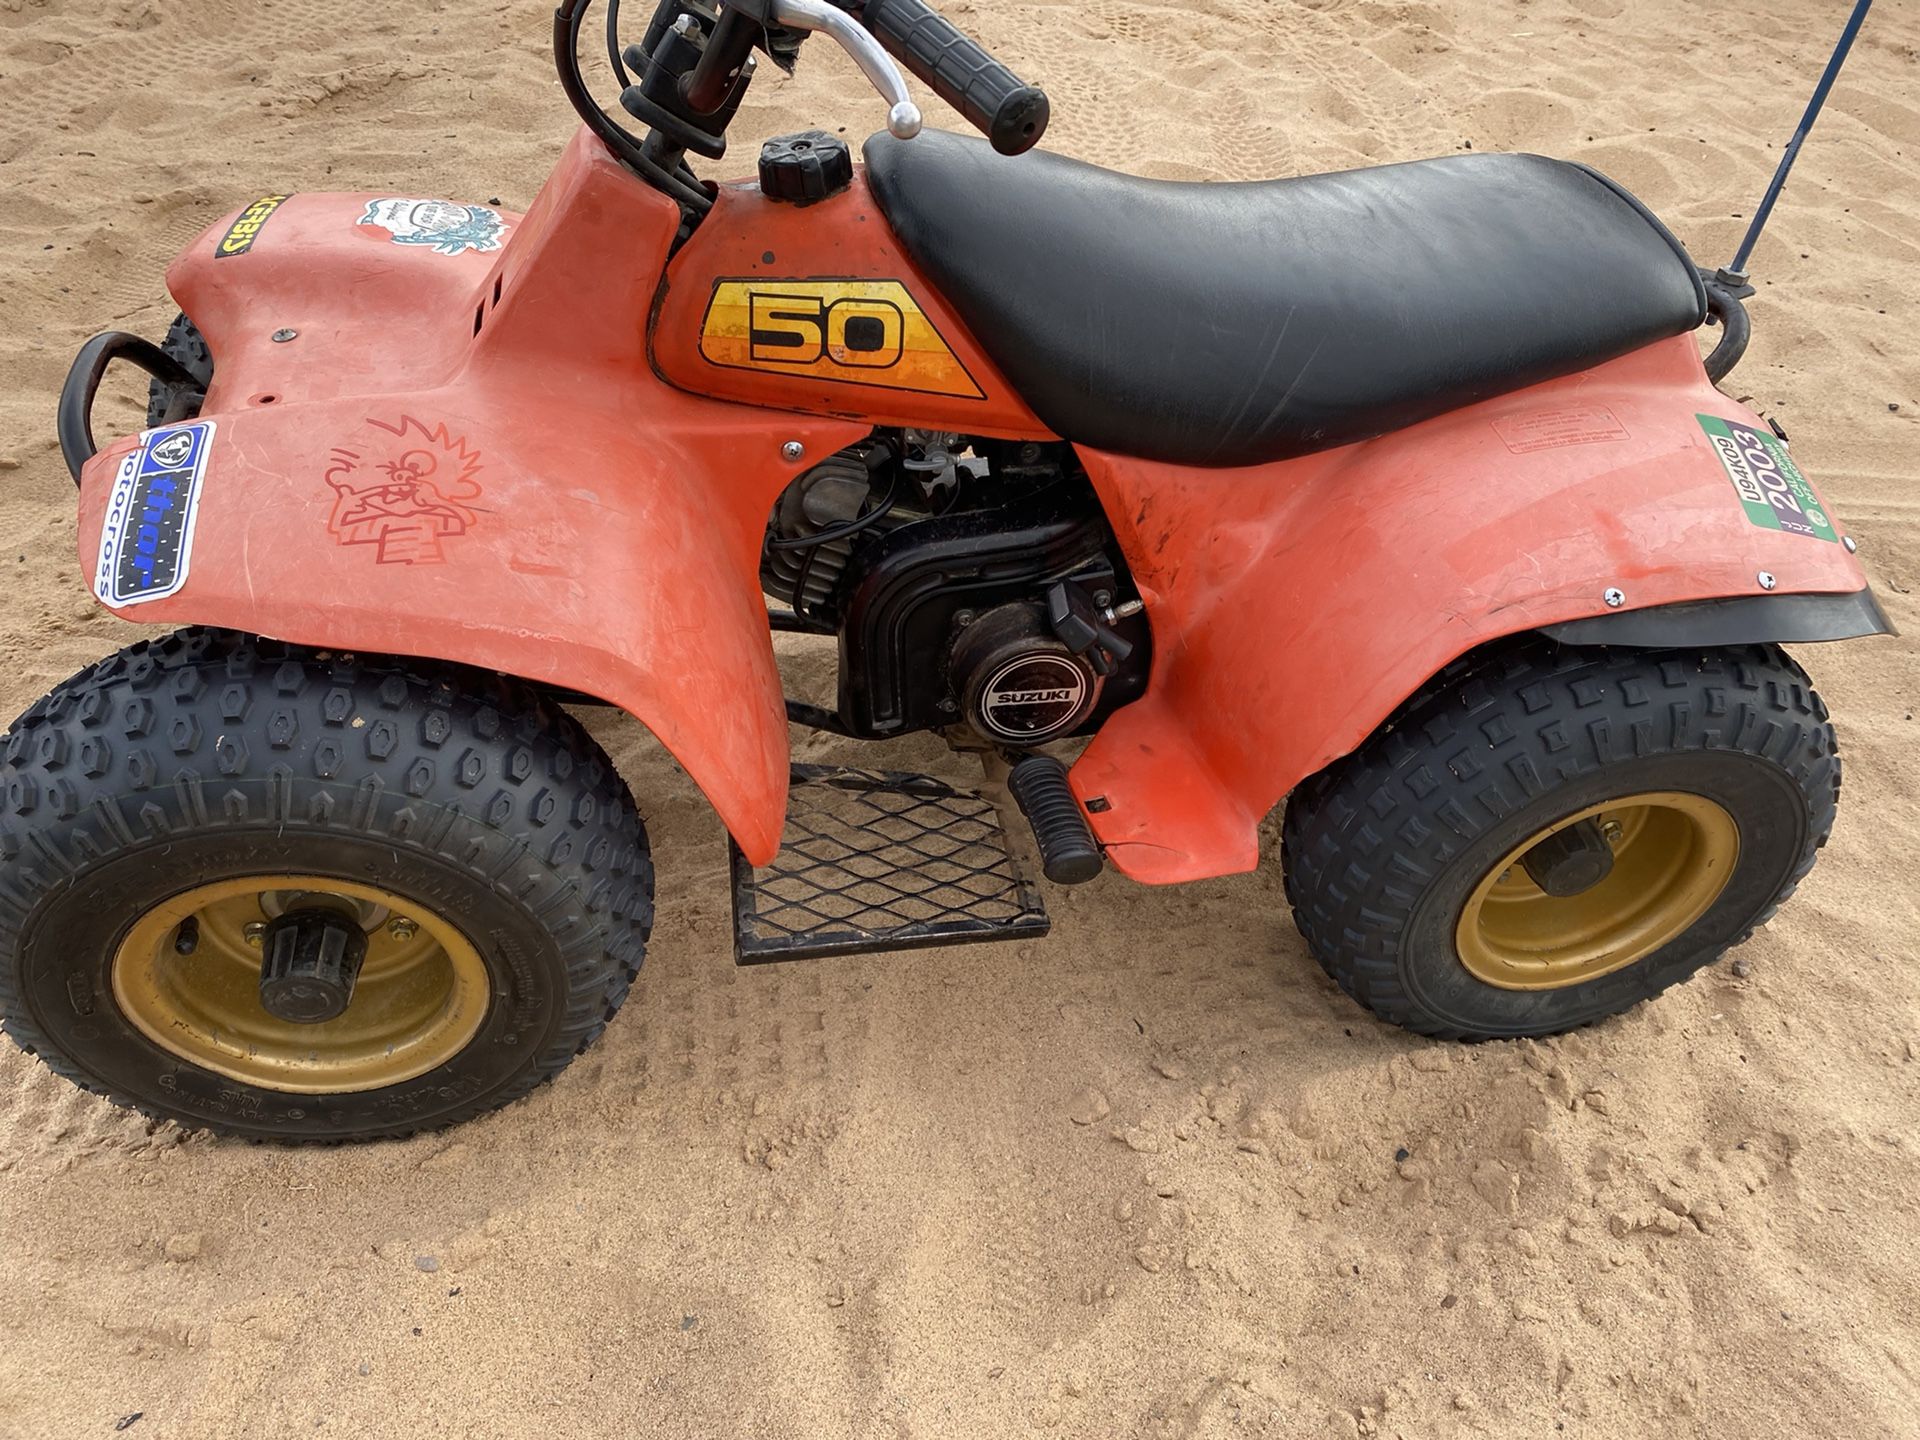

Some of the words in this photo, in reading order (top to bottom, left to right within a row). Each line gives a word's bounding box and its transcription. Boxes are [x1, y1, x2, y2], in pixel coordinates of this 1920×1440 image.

[750, 292, 904, 369] 50
[1717, 438, 1762, 501] U94K09
[1733, 429, 1802, 513] 2003
[134, 475, 178, 589] thor
[997, 690, 1071, 704] SUZUKI
